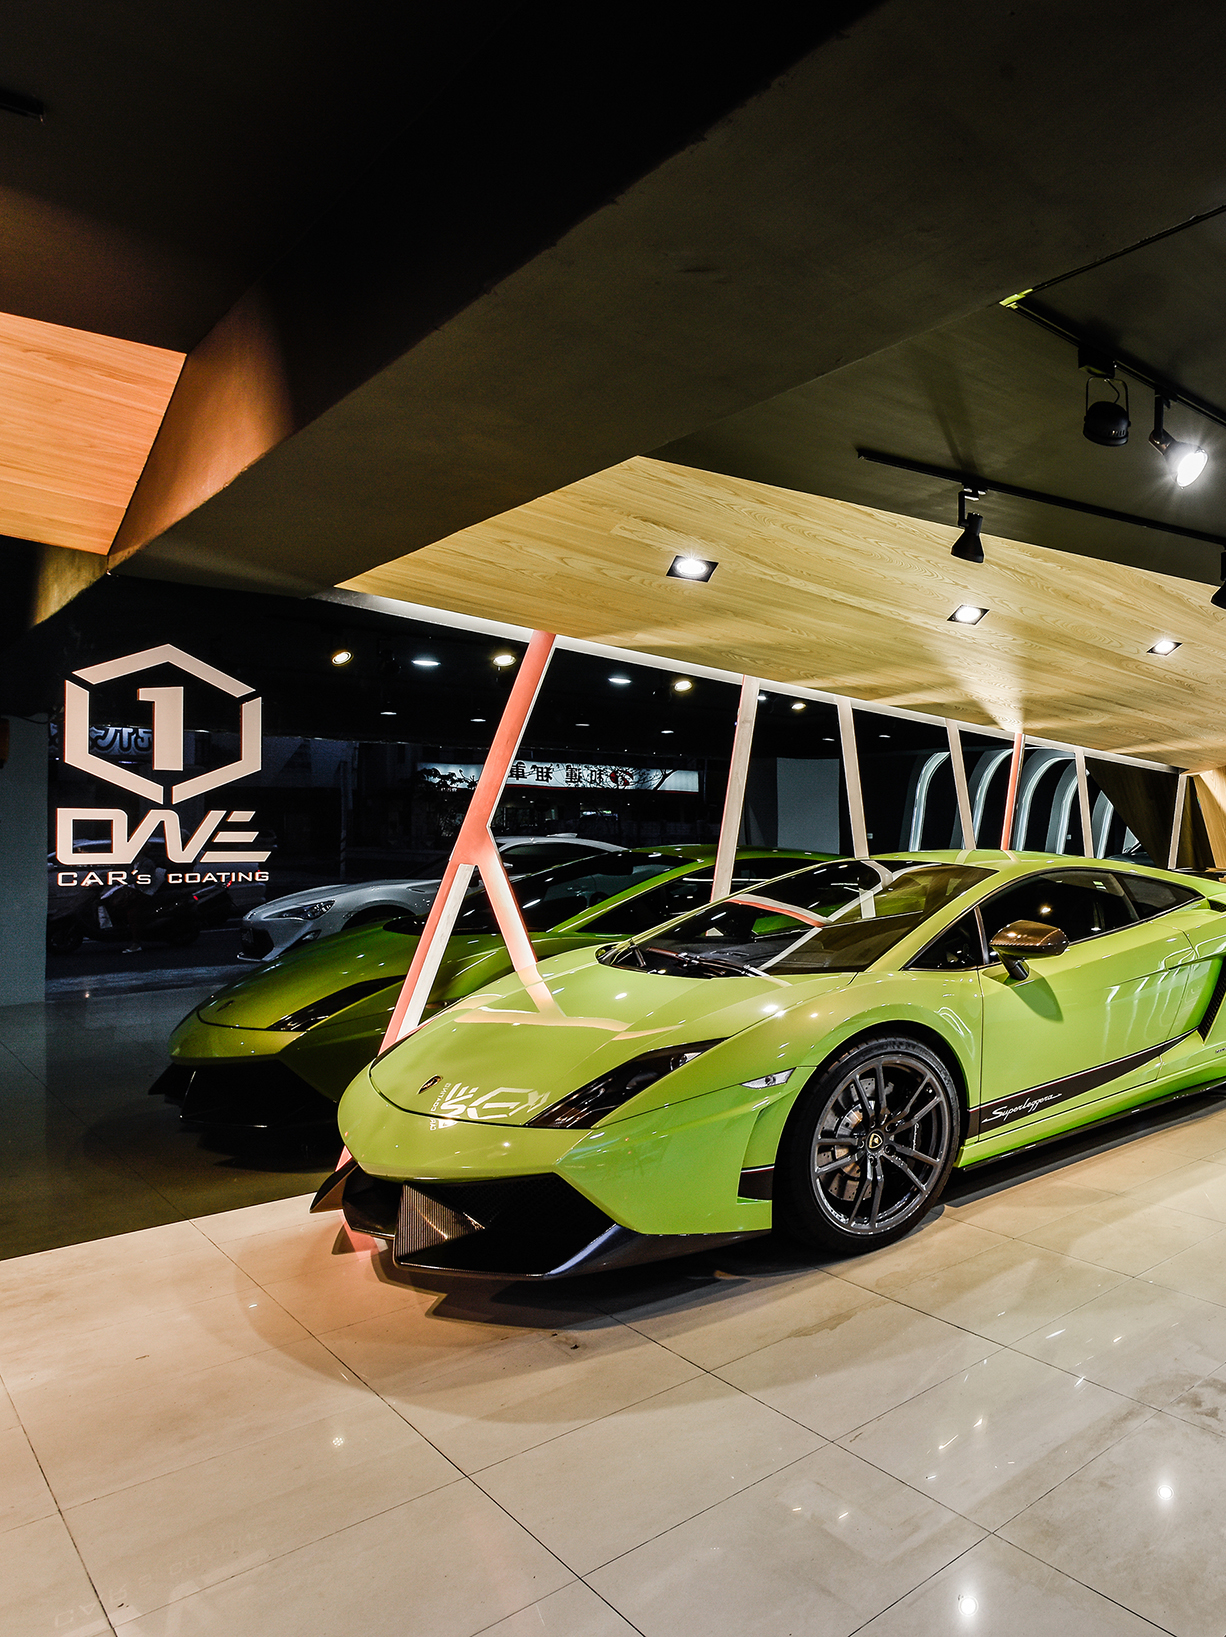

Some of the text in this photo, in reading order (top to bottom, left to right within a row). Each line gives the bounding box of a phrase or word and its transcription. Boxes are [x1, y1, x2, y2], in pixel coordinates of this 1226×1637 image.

[137, 686, 184, 771] 1
[56, 807, 272, 865] ONE
[167, 871, 270, 884] COATING
